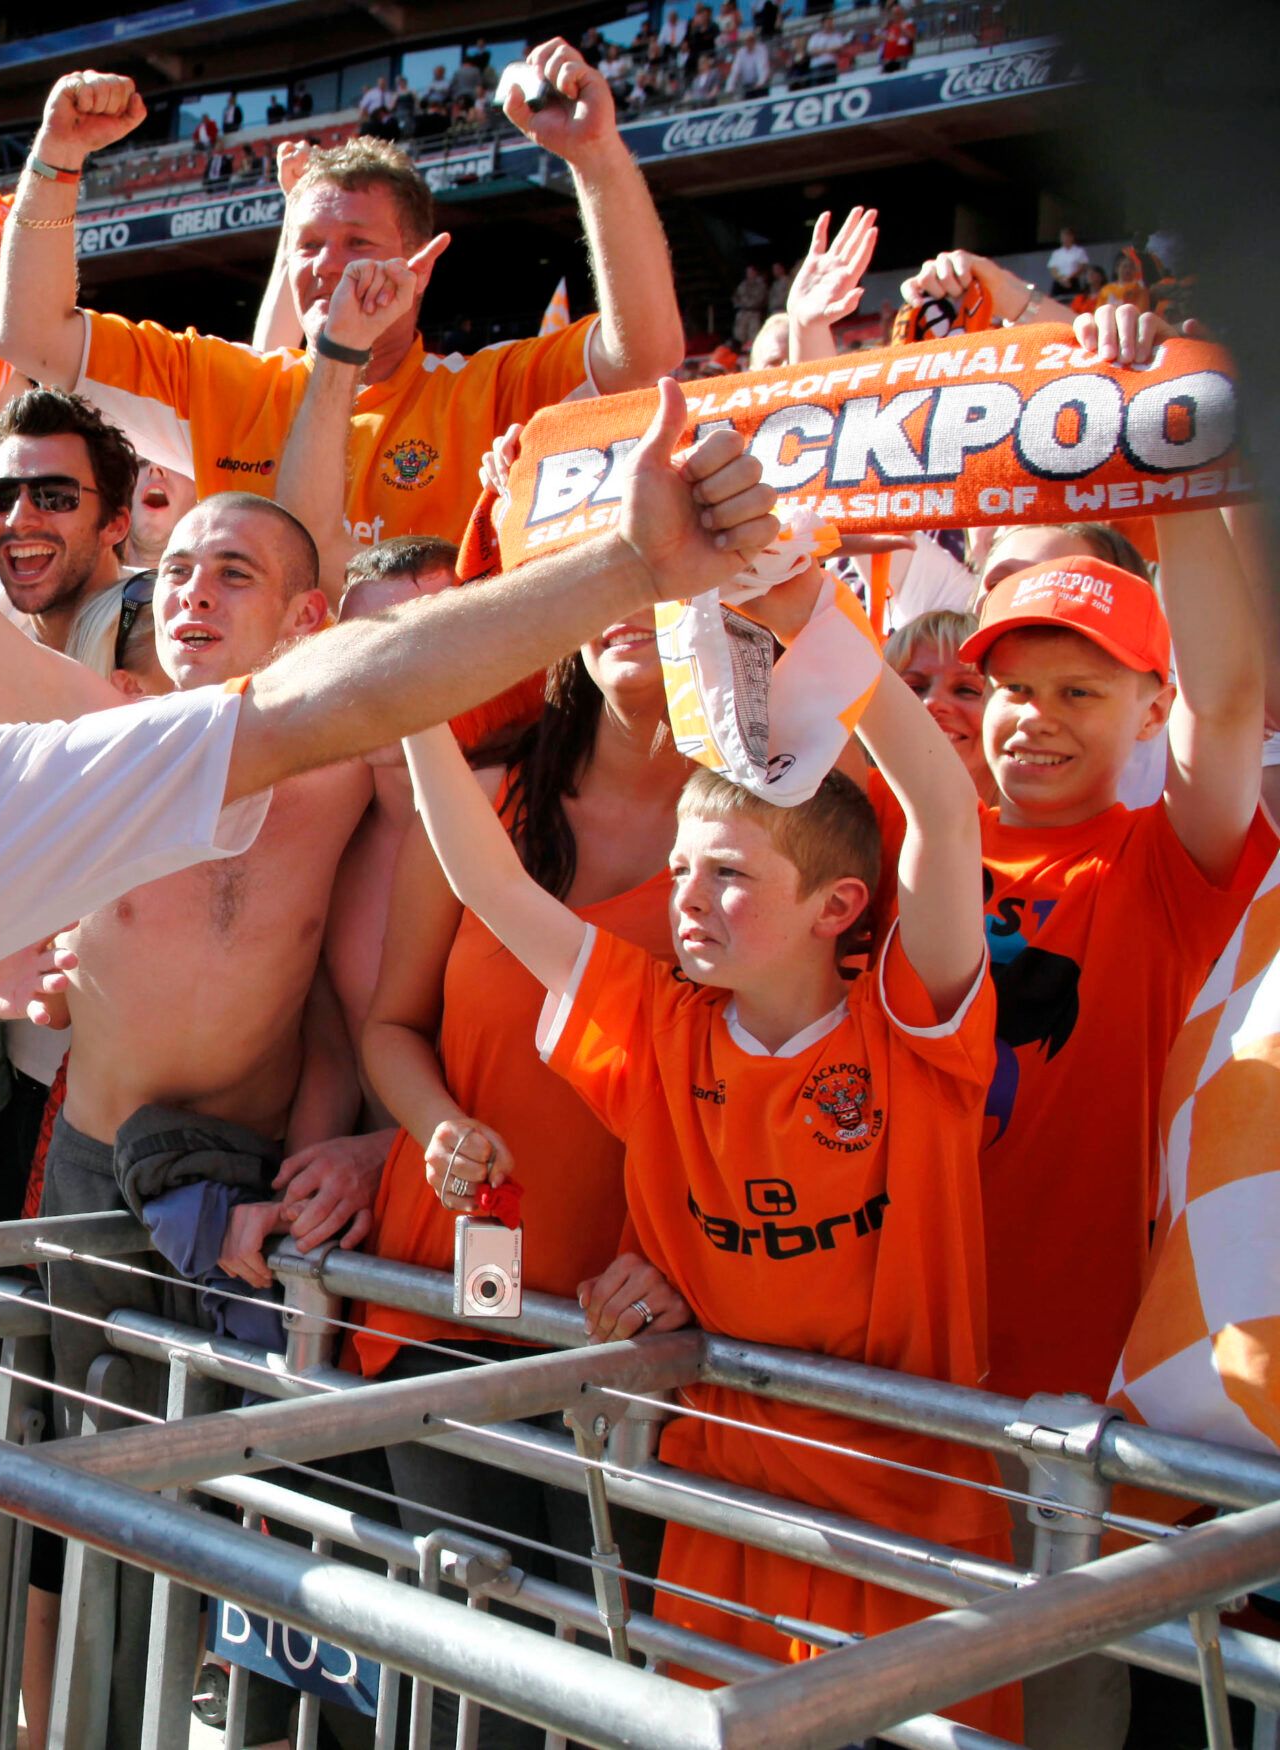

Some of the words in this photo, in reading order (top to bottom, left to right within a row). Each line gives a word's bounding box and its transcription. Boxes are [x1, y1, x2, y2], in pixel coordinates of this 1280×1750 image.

[662, 107, 760, 153] Coca-Cola
[770, 87, 871, 133] zero
[171, 206, 224, 237] GREAT
[225, 199, 279, 227] Coke
[887, 344, 1024, 385] FINAL
[978, 485, 1038, 515] OF
[1013, 571, 1114, 604] BLACKPOOL
[802, 1063, 872, 1100] BLACKPOOL
[812, 1131, 872, 1153] FOOTBALL
[870, 1108, 883, 1138] CLUB
